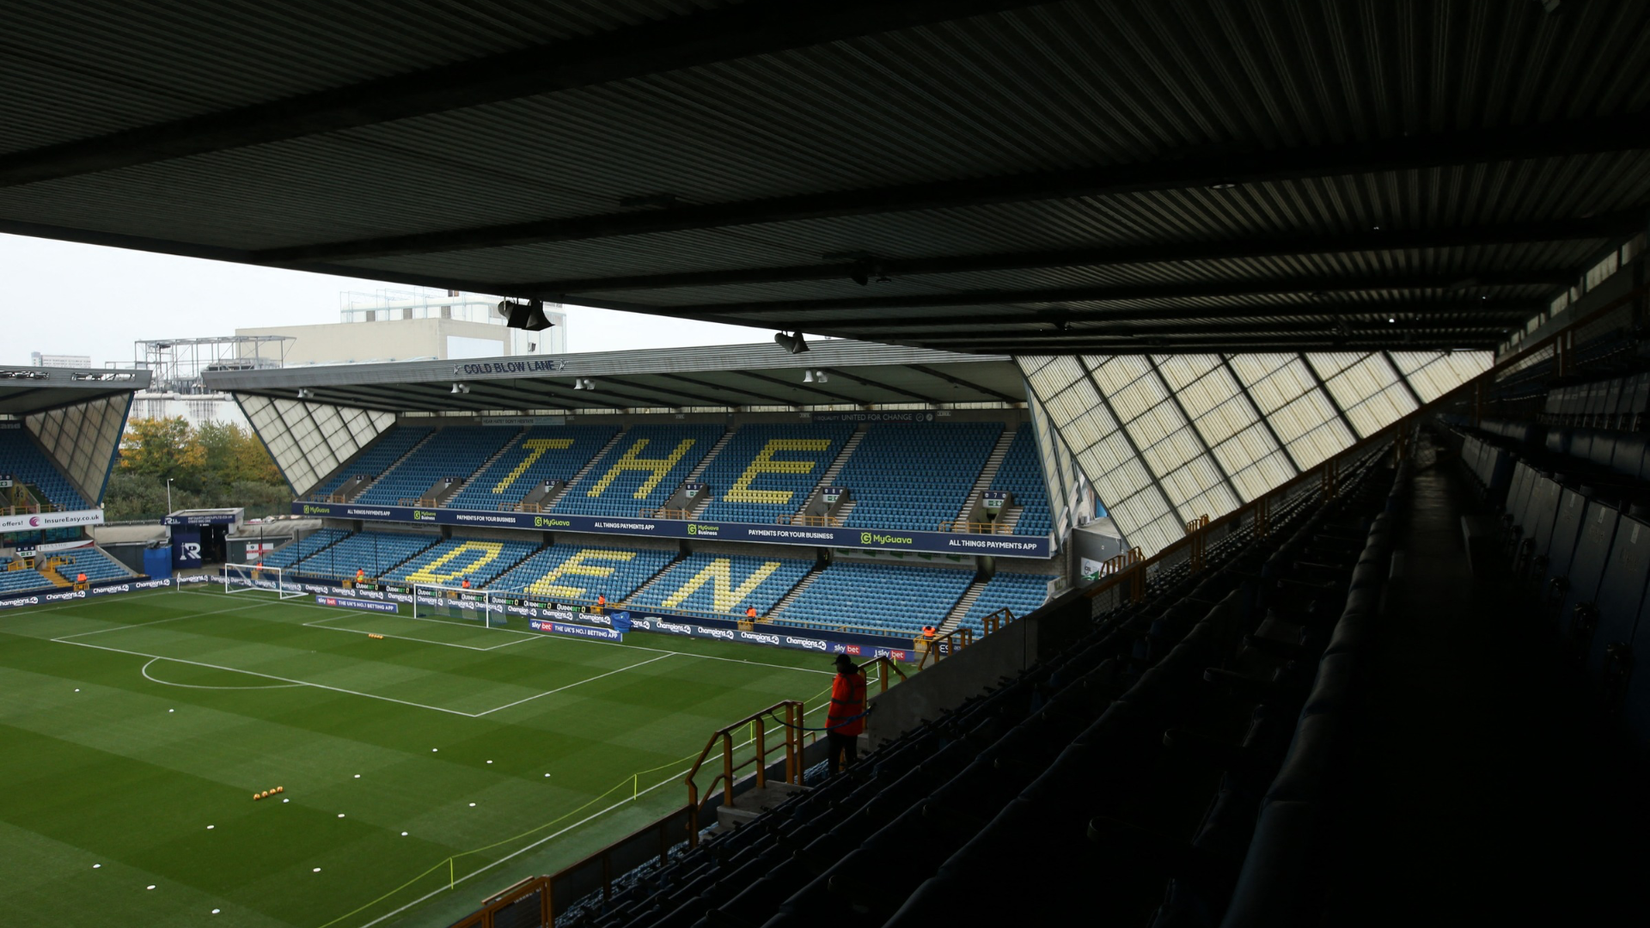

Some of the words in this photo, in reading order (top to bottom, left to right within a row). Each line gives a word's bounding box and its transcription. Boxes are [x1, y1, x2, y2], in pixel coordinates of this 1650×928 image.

[464, 363, 492, 374] COLD
[494, 361, 525, 374] BLOW
[526, 360, 556, 372] LANE
[492, 438, 832, 504] THE
[44, 514, 99, 524] InsureEasy.co.uk
[543, 519, 570, 527] MyGuava
[873, 535, 912, 544] MyGuava
[405, 540, 781, 614] DEN
[136, 580, 163, 588] Champions
[93, 585, 121, 594] Champions
[543, 609, 567, 619] Champions
[579, 613, 604, 622] Champions
[656, 621, 684, 631] Champions
[698, 627, 726, 636] Champions
[741, 632, 770, 642] Champions
[786, 636, 817, 647] Champions
[834, 644, 845, 653] sky
[848, 646, 859, 654] bet
[878, 649, 890, 658] sky
